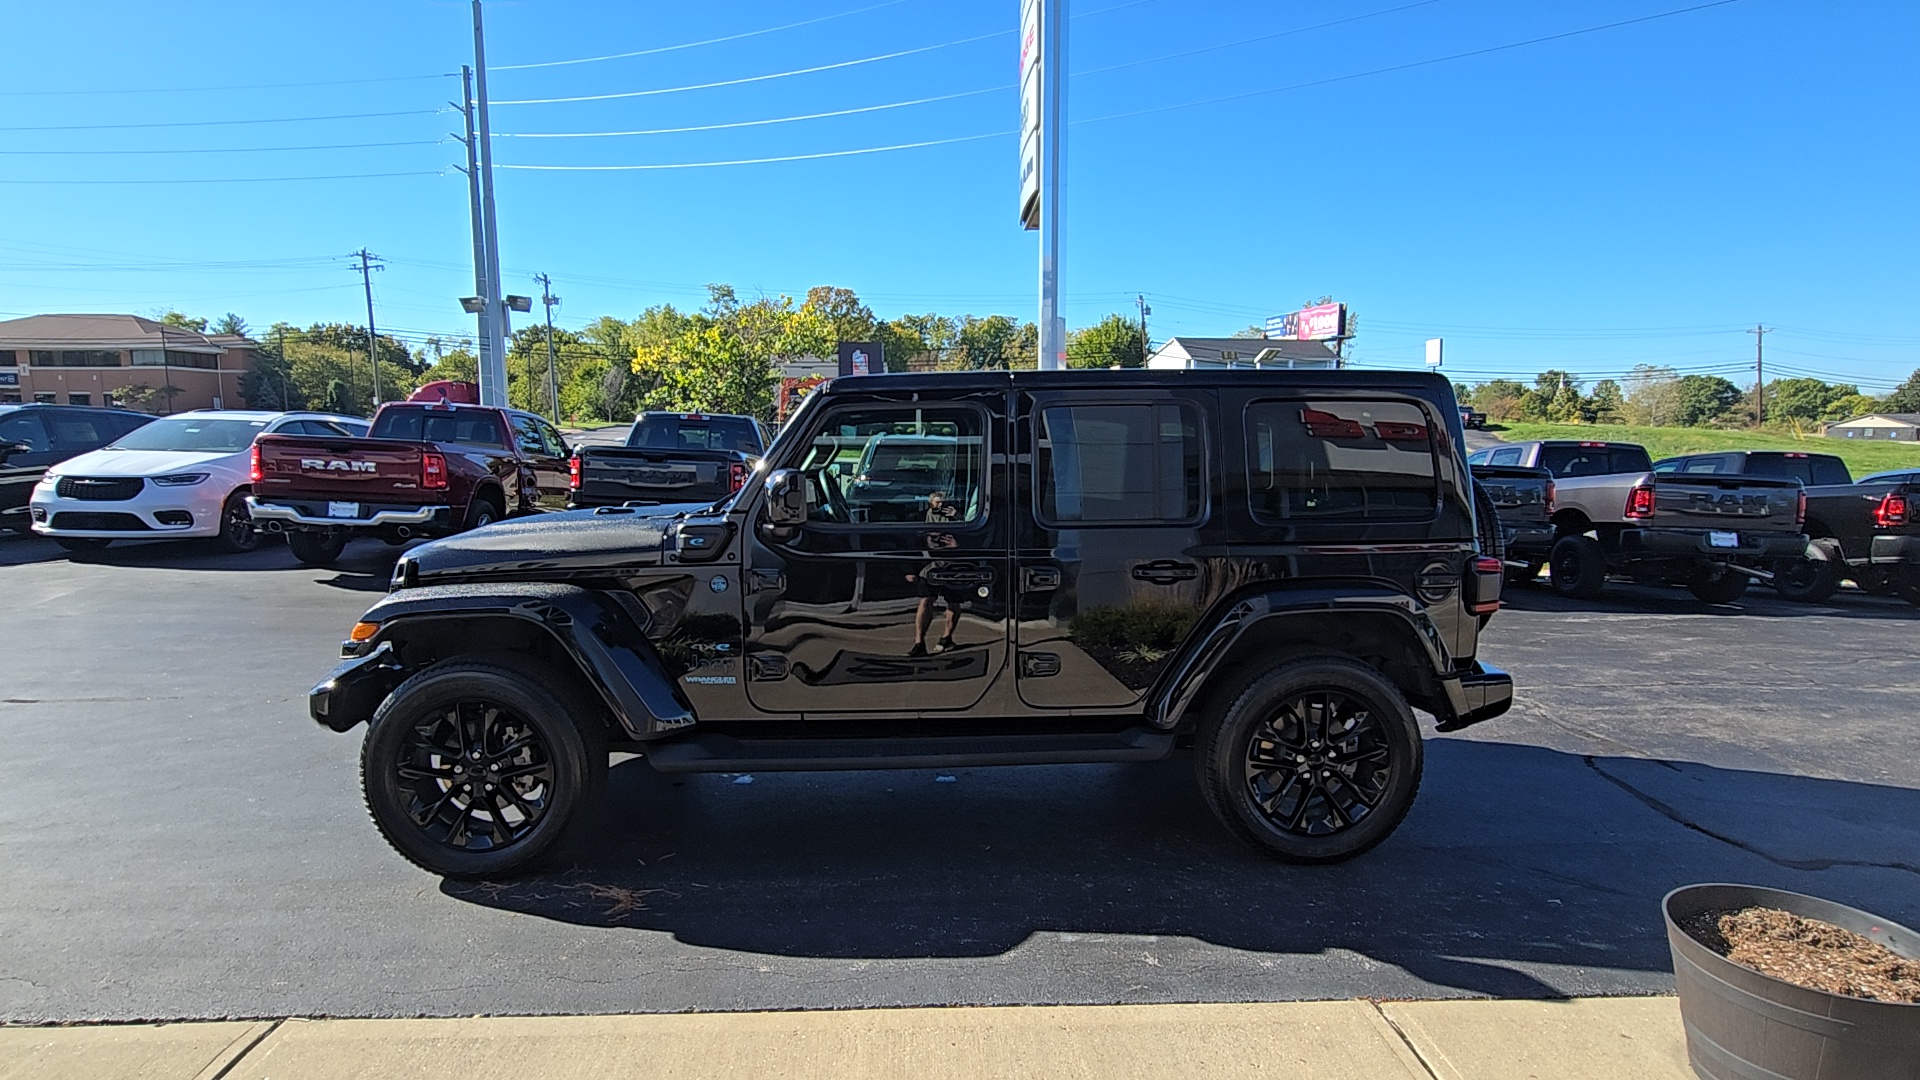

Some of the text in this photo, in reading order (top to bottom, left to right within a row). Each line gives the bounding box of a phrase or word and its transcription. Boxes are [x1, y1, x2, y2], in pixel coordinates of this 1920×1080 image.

[301, 458, 377, 473] RAM
[1689, 493, 1768, 506] RAM
[683, 654, 736, 674] Jeep
